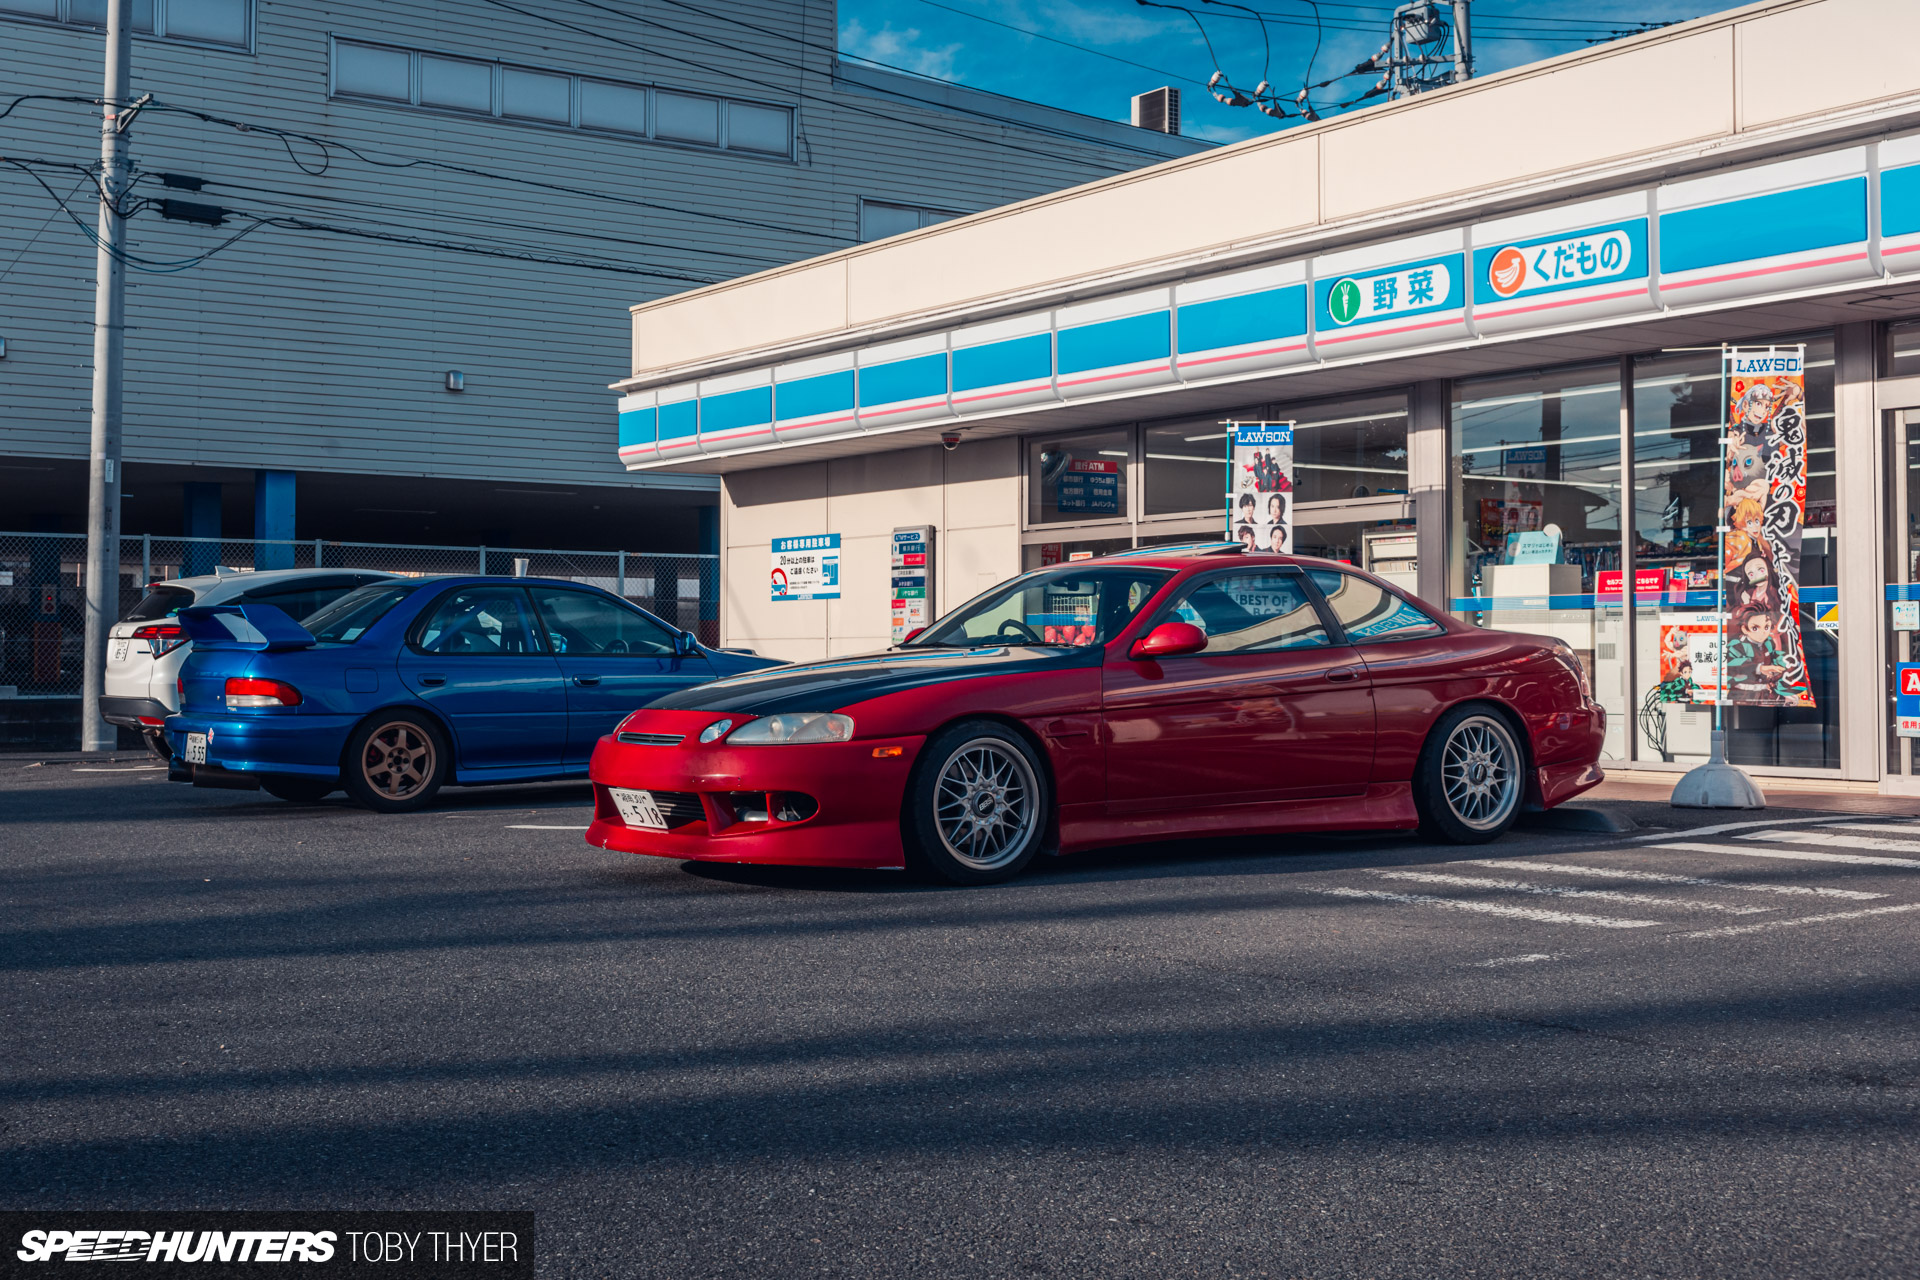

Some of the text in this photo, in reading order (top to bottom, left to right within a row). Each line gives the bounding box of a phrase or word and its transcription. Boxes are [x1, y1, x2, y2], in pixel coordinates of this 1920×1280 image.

[1533, 237, 1623, 281] くだもの
[1373, 270, 1434, 311] 野菜
[1237, 431, 1291, 443] LAWSON
[780, 537, 831, 550] お客様専用駐車場
[1272, 595, 1288, 606] OF
